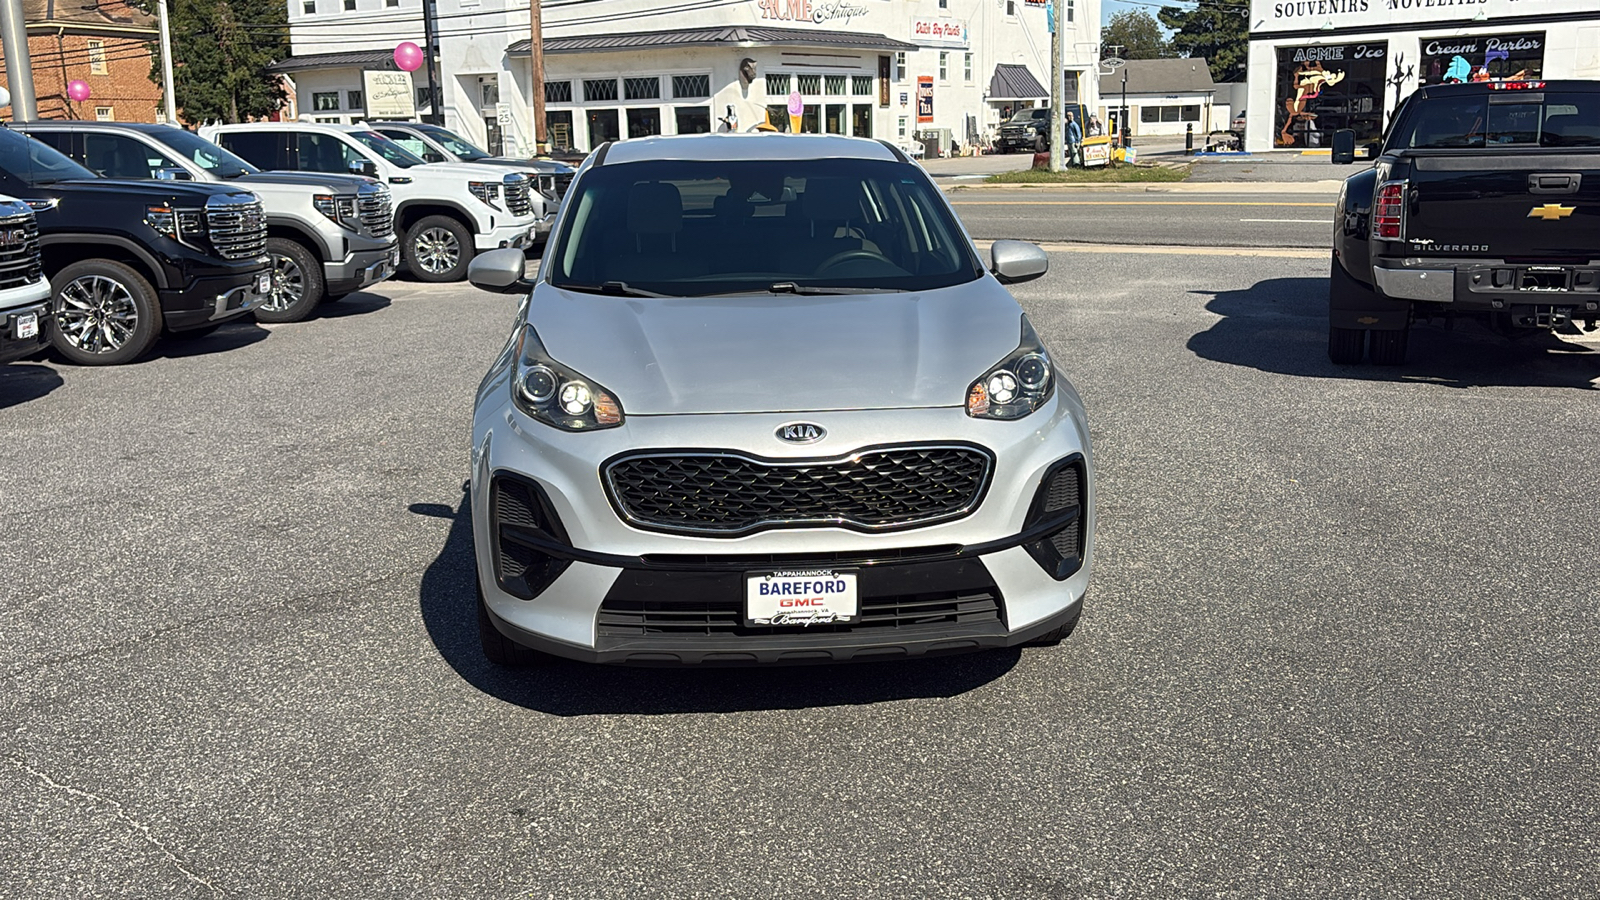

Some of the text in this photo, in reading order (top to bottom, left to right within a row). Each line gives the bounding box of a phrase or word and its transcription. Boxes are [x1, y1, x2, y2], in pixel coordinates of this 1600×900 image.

[757, 0, 869, 25] ACME Antiques
[1274, 0, 1488, 18] SOUVENIRS NOVEL
[915, 21, 961, 38] Dutch Boy Paints
[1293, 45, 1385, 62] ACME Ice
[1425, 37, 1542, 55] Cream Parlor
[920, 101, 932, 114] TEA
[499, 114, 509, 123] 25
[0, 228, 25, 247] MC
[1414, 244, 1489, 252] SILVERADO
[783, 425, 819, 439] KIA
[773, 569, 833, 578] TAPPAHANNOCK
[759, 580, 846, 596] BAREFORD
[780, 597, 824, 607] GMC
[770, 612, 836, 627] Bareford
